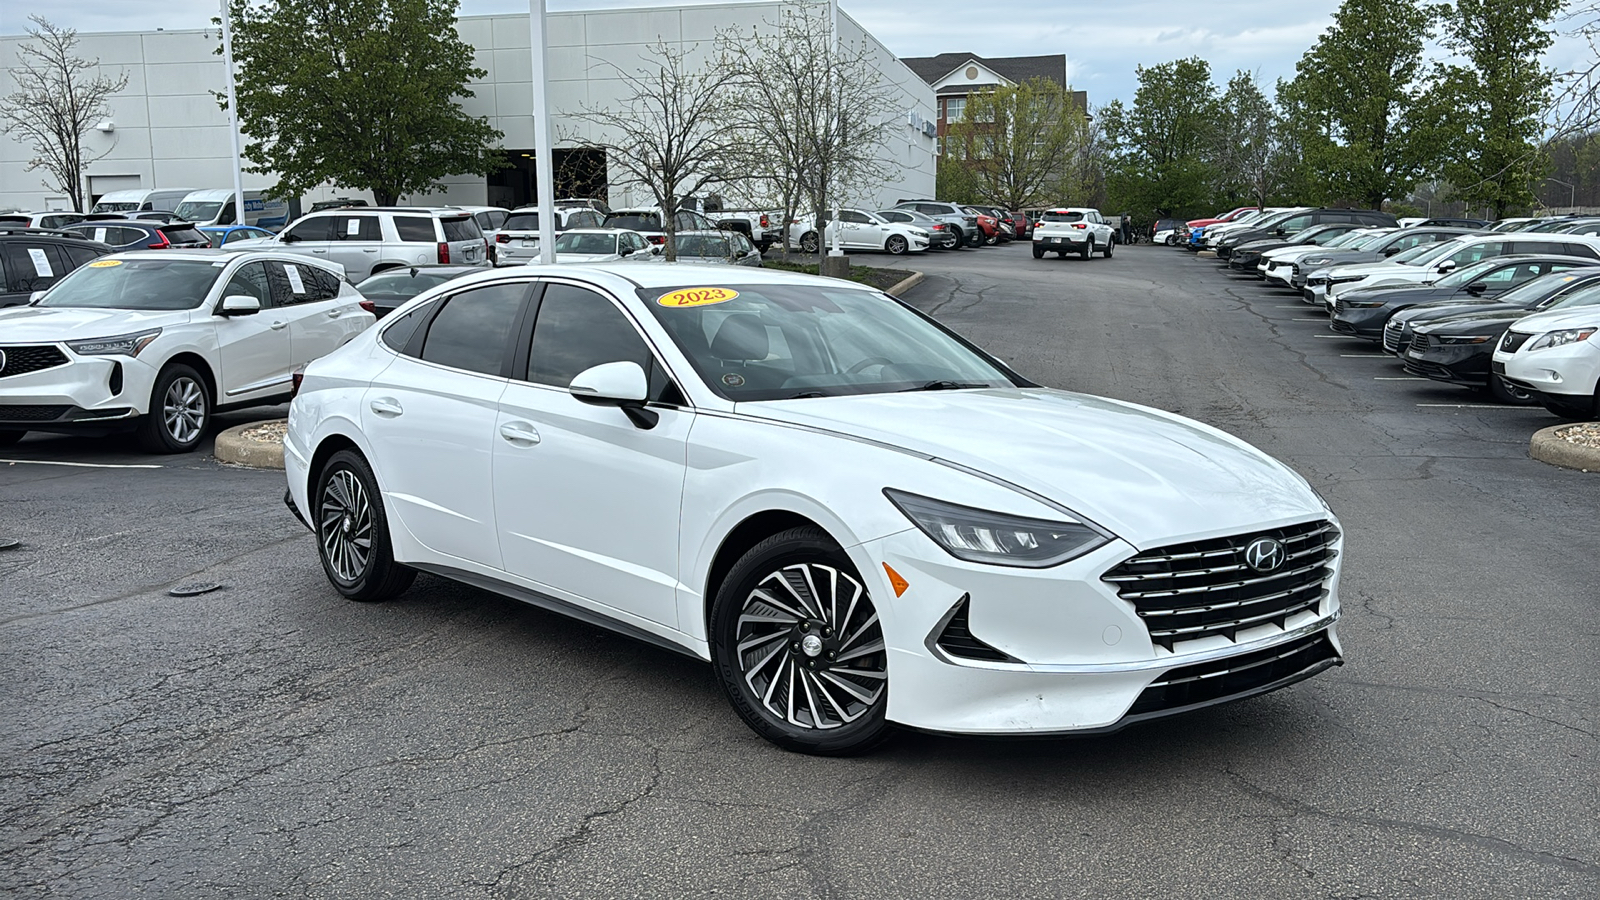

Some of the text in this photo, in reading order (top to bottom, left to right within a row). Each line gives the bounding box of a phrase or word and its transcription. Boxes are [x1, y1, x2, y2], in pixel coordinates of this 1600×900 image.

[673, 289, 726, 305] 2023
[722, 664, 771, 732] KINERGY GT
